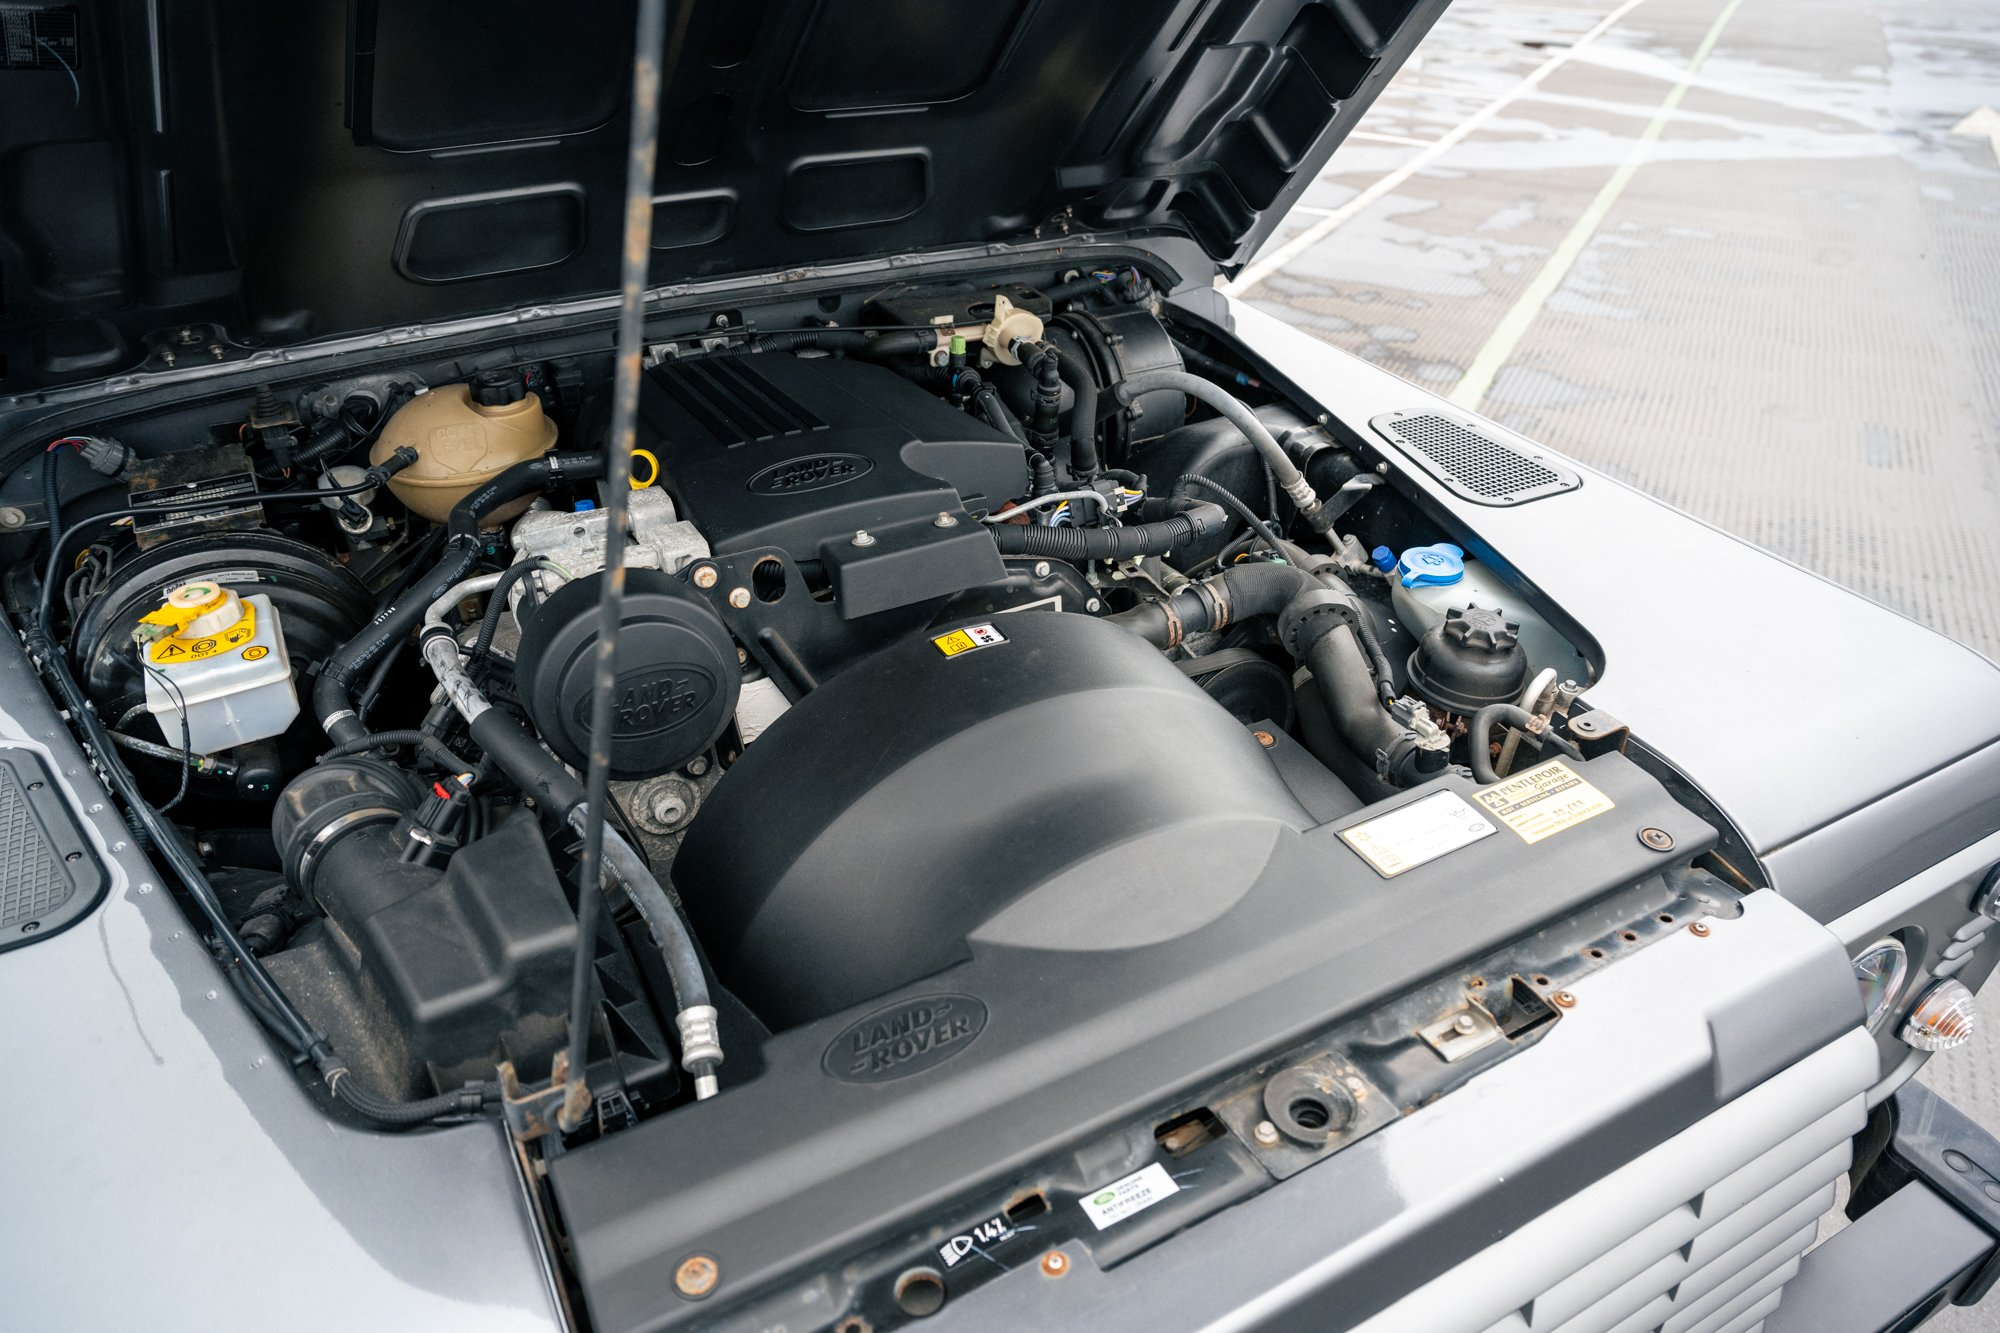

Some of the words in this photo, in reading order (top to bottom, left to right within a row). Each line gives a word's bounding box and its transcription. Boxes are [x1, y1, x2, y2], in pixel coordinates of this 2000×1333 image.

[437, 425, 476, 439] COLD
[434, 438, 483, 456] LEVEL
[773, 459, 830, 480] LAND
[786, 464, 857, 488] ROVER
[190, 651, 210, 659] DOT
[612, 678, 673, 708] AND
[619, 690, 697, 726] ROVER
[1498, 765, 1564, 795] PENTLEPOIR
[1533, 772, 1570, 791] Garage
[1501, 807, 1515, 815] MOT
[1520, 792, 1551, 806] SERVICING
[1554, 780, 1578, 791] REPAIRS
[853, 1007, 935, 1055] LAND
[871, 1016, 973, 1073] ROVER
[1100, 1187, 1152, 1215] ANTIFREEZE
